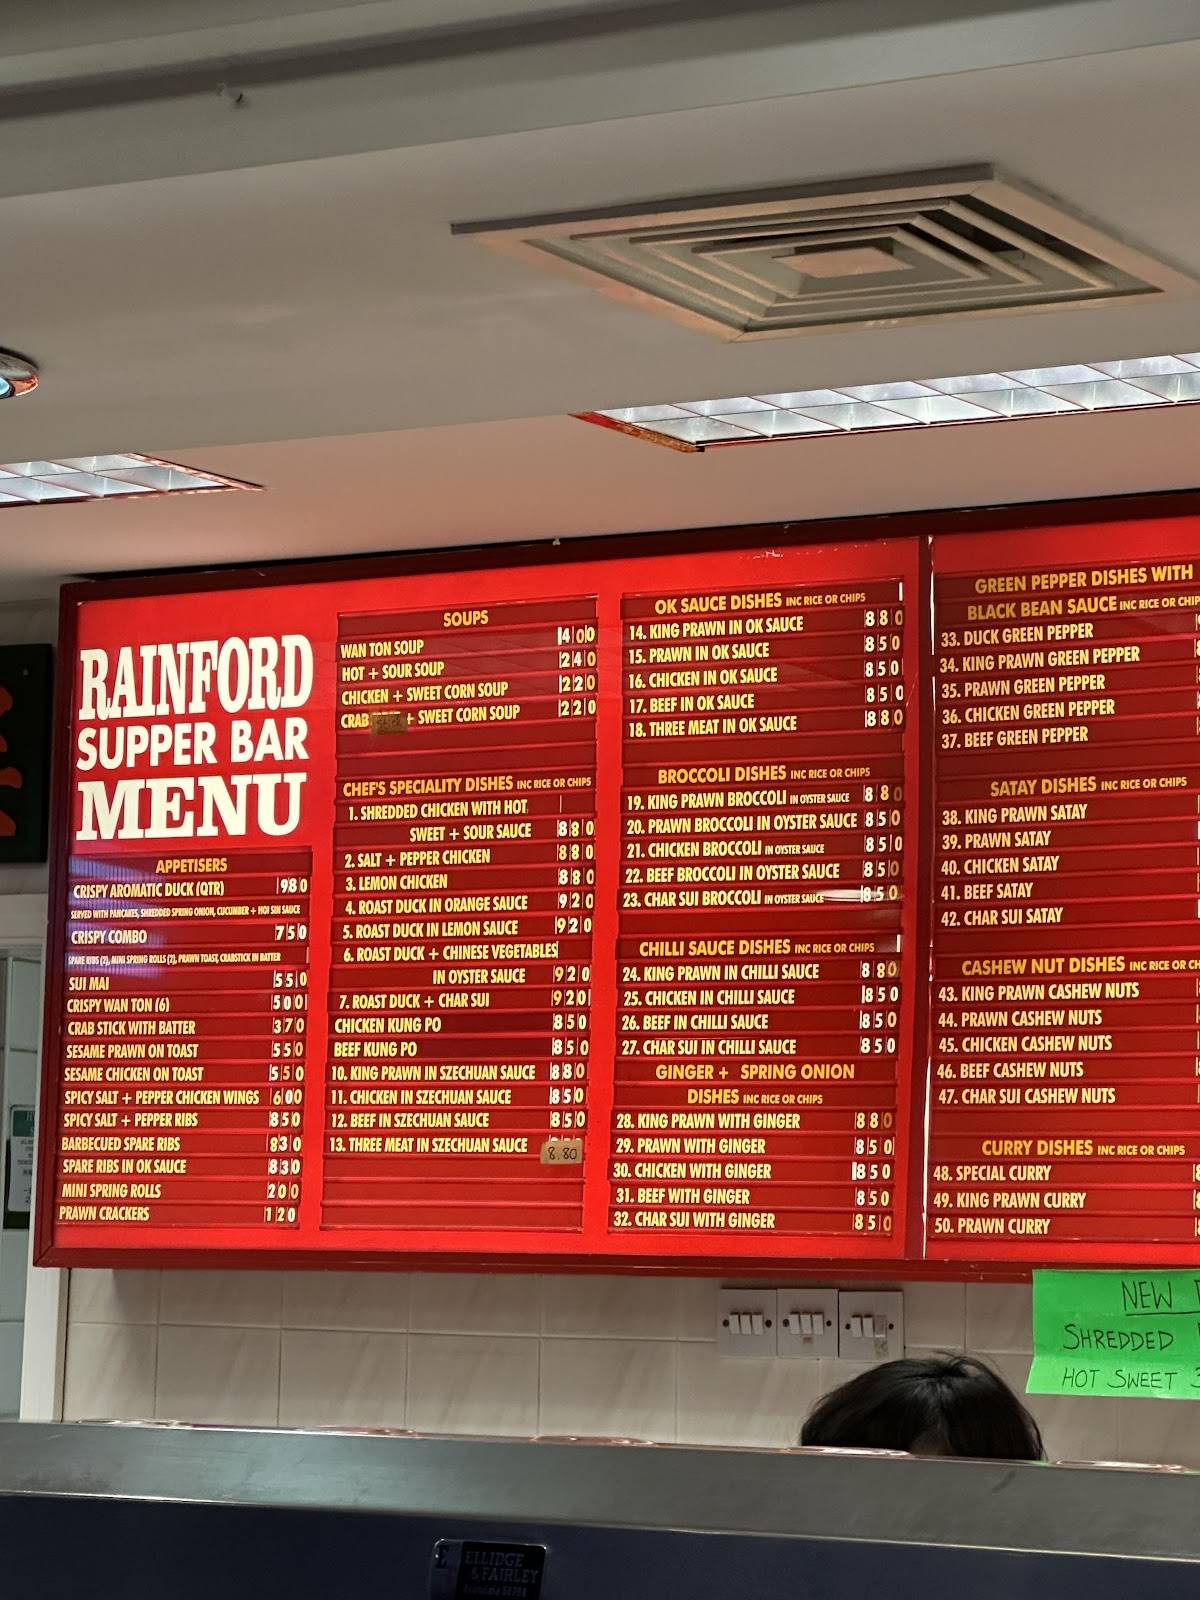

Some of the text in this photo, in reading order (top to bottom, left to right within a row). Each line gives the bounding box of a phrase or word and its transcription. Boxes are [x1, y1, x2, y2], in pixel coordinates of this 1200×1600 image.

[975, 563, 1193, 593] GREEN PEPPER DISHES WITH
[654, 592, 865, 614] OK SAUCE DISHES INC RICE OR CHIPS
[967, 595, 1176, 620] BLACK BEAN SAUCE INC RICE OR
[443, 609, 488, 627] SOUPS
[629, 615, 803, 640] 14. KING PRAWN IN OK SAUCE
[941, 622, 1093, 647] 33. DUCK GREEN PEPPER
[78, 634, 313, 720] RAINFORD
[341, 661, 444, 681] HOT + SOUR SOUP
[76, 716, 309, 771] SUPPER BAR
[657, 764, 870, 784] BROCCOLI DISHES INC RICE OR CHIPS
[342, 775, 591, 797] CHEF'S SPECIALITY DISHES INC RICE OR CHIPS
[990, 775, 1187, 797] SATAY DISHES INC RICE OR CHIPS
[75, 773, 307, 840] MENU
[626, 812, 857, 834] 20. PRAWN BROCCOLI IN OYSTER SAUCE
[155, 857, 227, 873] APPETISERS
[73, 880, 224, 899] CRISPY AROMATIC DUCK (QTR)
[250, 906, 256, 915] +
[344, 895, 528, 915] 4. ROAST DUCK IN ORANGE SAUCE
[71, 929, 147, 944] CRISPY COMBO
[639, 938, 874, 957] CHILLI SAUCE DISHES INC RICE OR CHIPS
[961, 955, 1125, 975] CASHEW NUT DISHES
[333, 1041, 417, 1057] BEEF KUNG PO
[621, 1038, 796, 1055] 27. CHAR SUI IN CHILLI SAUCE
[331, 1064, 535, 1080] 10. KING PRAWN IN SZECHUAN SAUCE
[655, 1063, 854, 1079] GINGER + SPRING ONION
[64, 1089, 259, 1104] SPICY SALT + PEPPER CHICKEN WINGS
[687, 1088, 823, 1104] DISHES INC RICE OR CHIPS
[61, 1136, 180, 1151] BARBECUED SPARE RIBS
[981, 1139, 1093, 1155] CURRY DISHES
[933, 1165, 1051, 1181] 48. SPECIAL CURRY
[59, 1205, 149, 1221] PRAWN CRACKERS
[1121, 1281, 1172, 1311] NEW
[1064, 1324, 1174, 1351] SHREDDED
[1062, 1367, 1177, 1390] HOT SWEET
